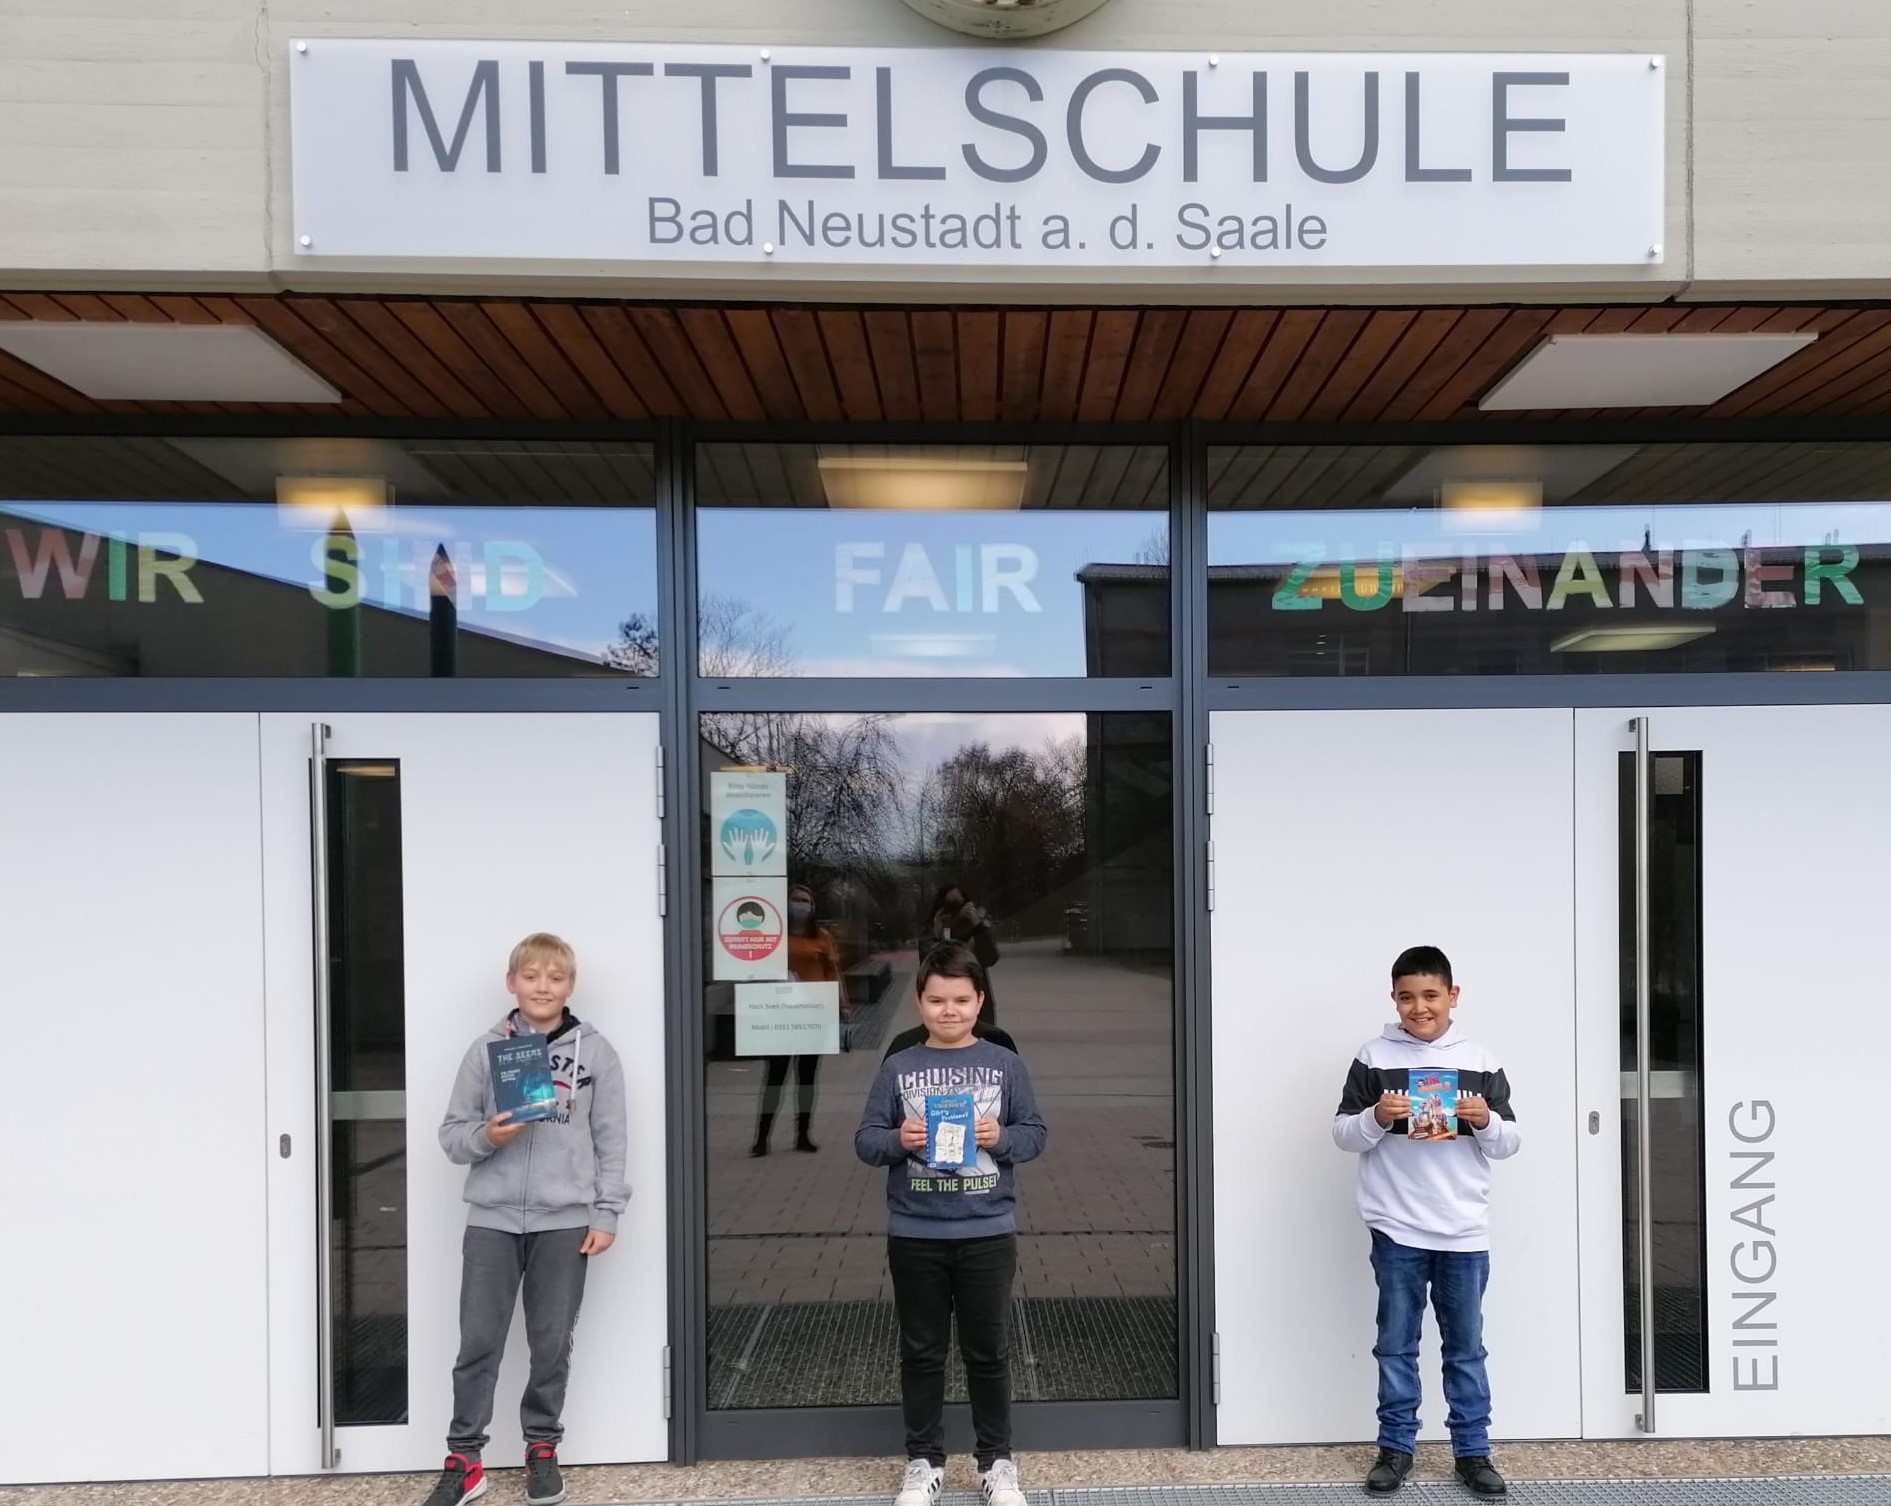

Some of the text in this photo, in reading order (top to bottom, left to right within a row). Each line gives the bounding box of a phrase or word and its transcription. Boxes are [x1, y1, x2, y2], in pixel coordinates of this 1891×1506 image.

[391, 58, 1573, 184] MITTELSCHULE
[647, 196, 1328, 251] Bad Neustadt a. d. Saale
[5, 528, 1864, 613] WIR SIND FAIR ZUEINANDER
[911, 1178, 933, 1192] FEEL
[936, 1178, 959, 1192] THE
[1728, 1099, 1779, 1391] EINGANG
